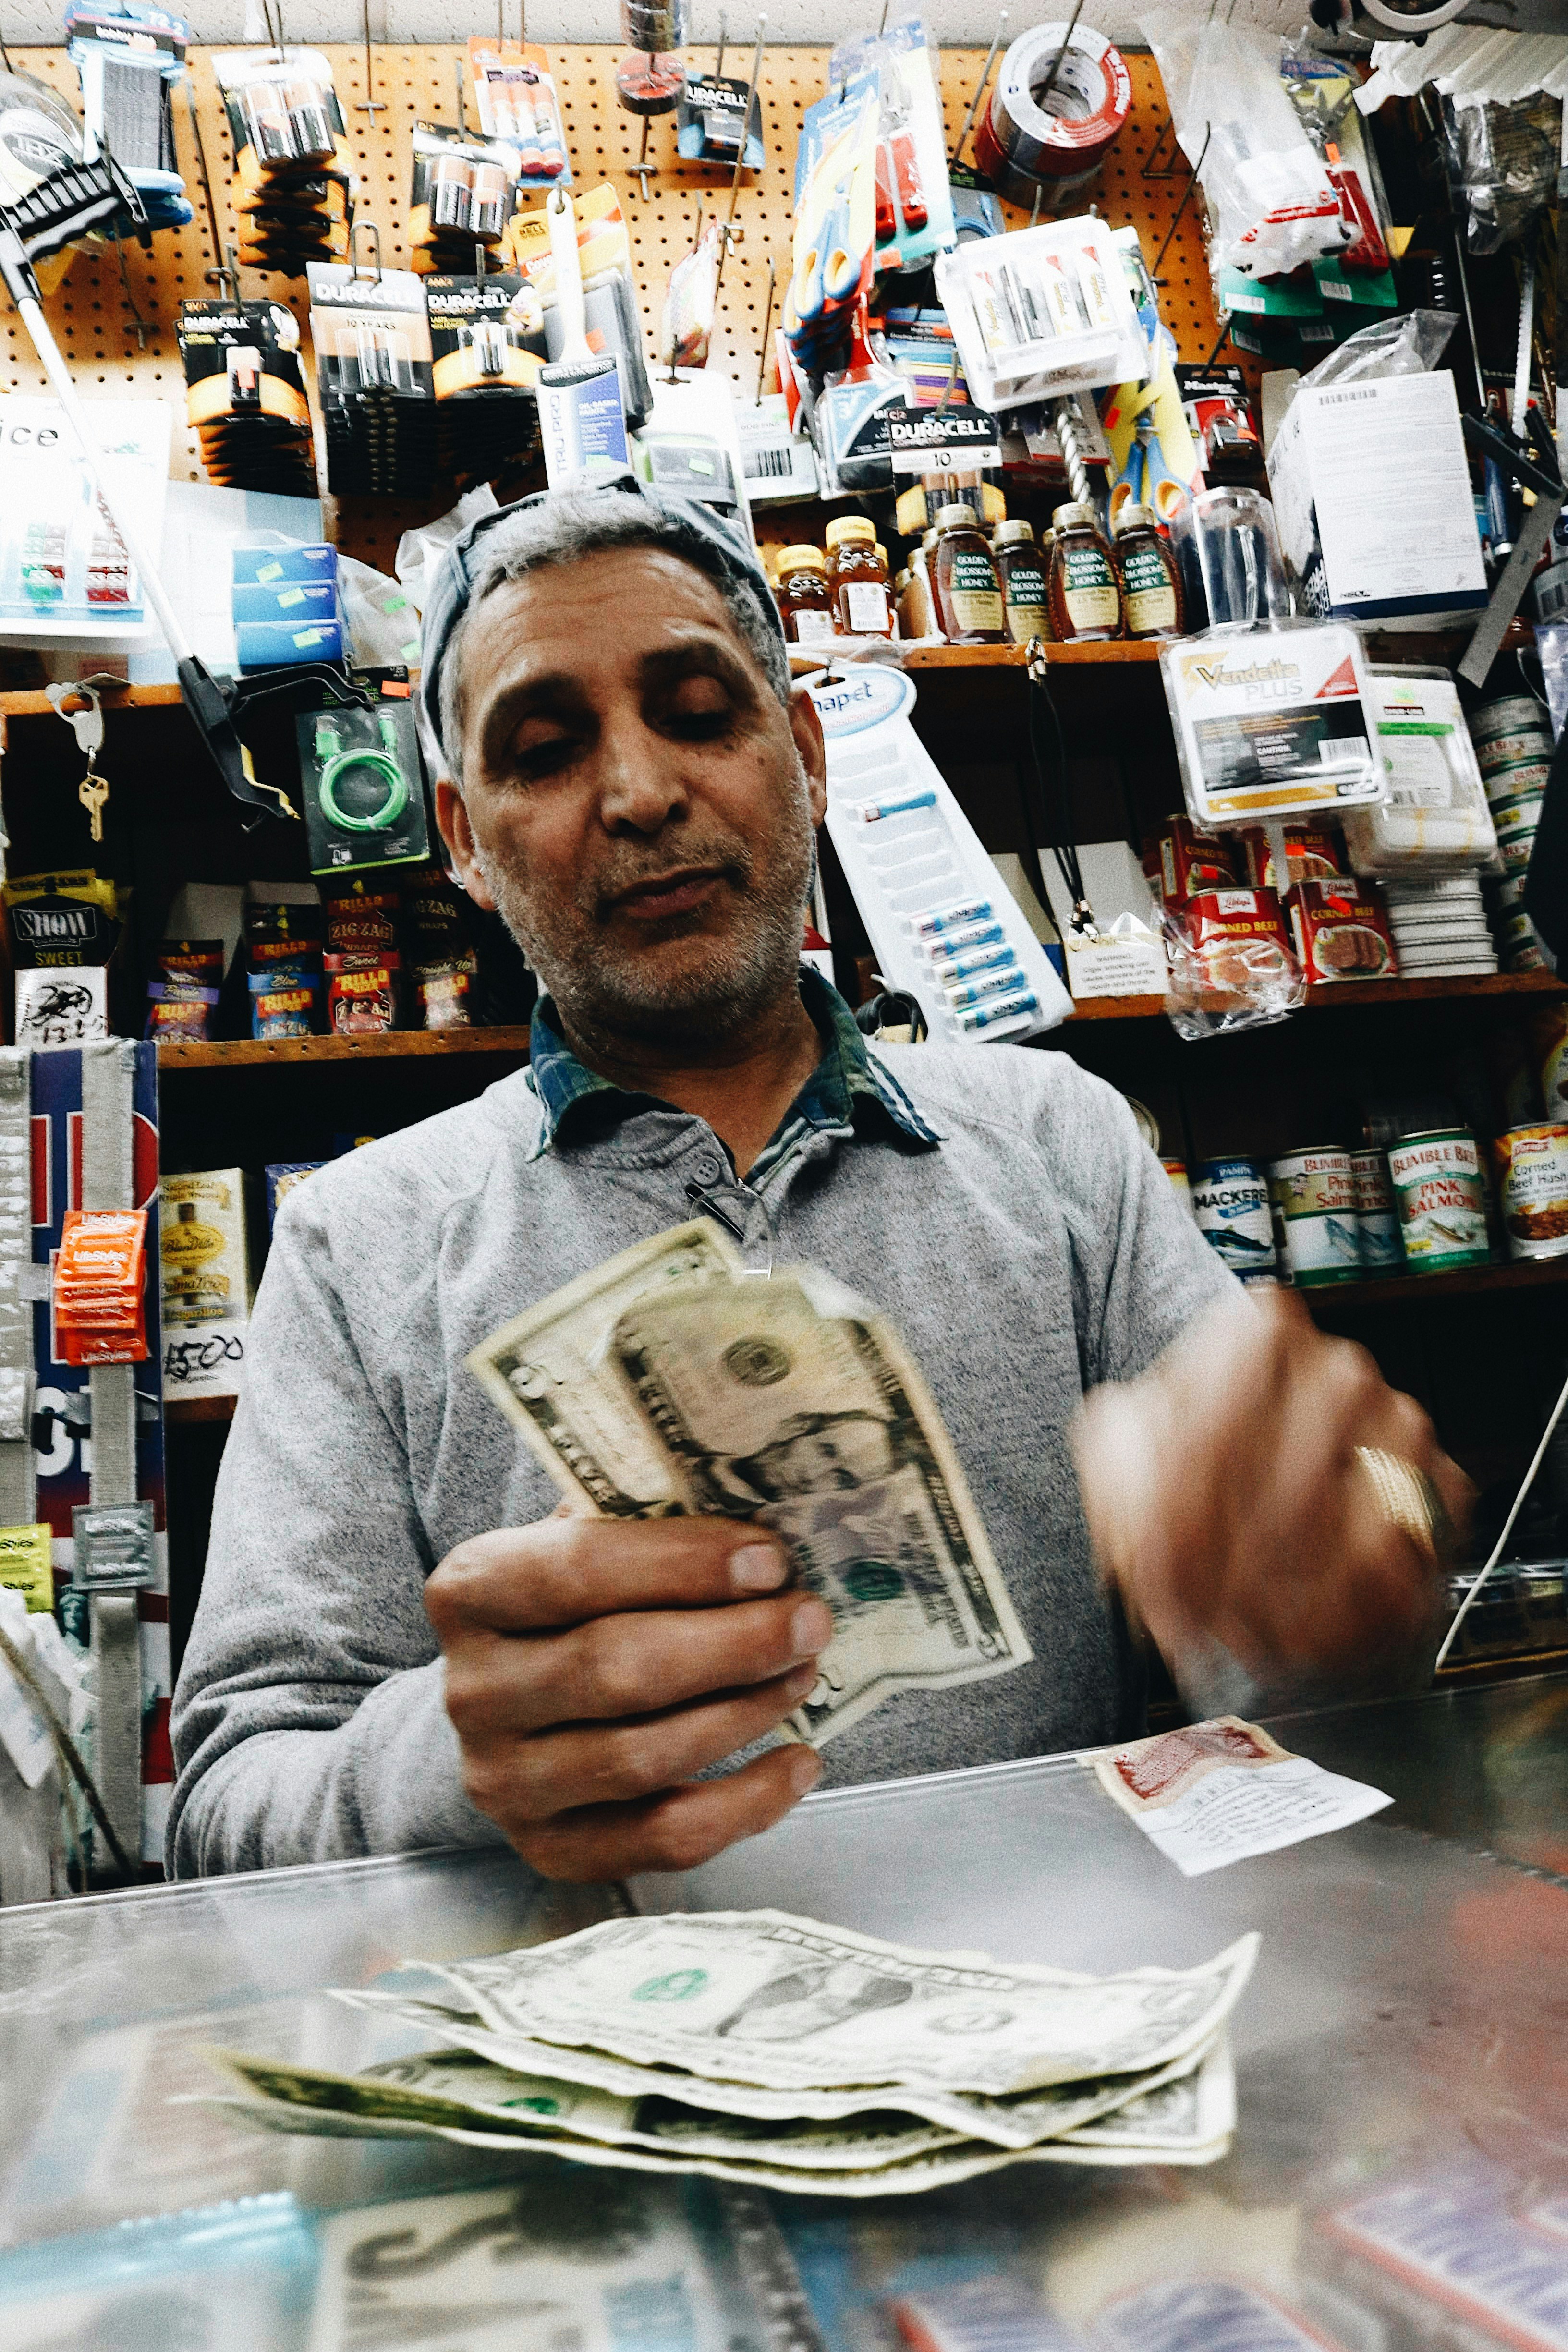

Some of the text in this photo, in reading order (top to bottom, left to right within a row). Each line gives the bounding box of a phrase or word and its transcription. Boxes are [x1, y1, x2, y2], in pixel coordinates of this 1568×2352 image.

[686, 85, 749, 109] URACELL
[427, 293, 511, 309] DURACELL
[184, 316, 250, 329] DURACELL
[359, 320, 396, 330] YEARS
[890, 419, 992, 440] DURACELL
[934, 452, 952, 466] 10
[956, 556, 989, 565] GOLDEN
[1070, 552, 1103, 564] GOLDEN
[1125, 553, 1158, 568] GOLDEN
[956, 567, 994, 576] BLOSSOM
[1011, 570, 1042, 580] GOLDEN
[1069, 563, 1107, 576] BLOSSOM
[1125, 564, 1164, 580] BLOSSOM
[961, 578, 989, 588] HONEY
[1011, 582, 1045, 591] BLOSSOM
[1074, 575, 1103, 586] HONEY
[1130, 576, 1159, 590] HONEY
[1016, 593, 1042, 602] HONEY
[1196, 658, 1300, 690] Vendetta
[813, 681, 872, 712] hapet
[1245, 680, 1303, 699] PLUS
[1354, 906, 1374, 916] BEEF
[20, 911, 87, 938] SHOW
[1254, 921, 1279, 932] BEEF
[35, 951, 84, 966] SWEET
[1394, 1148, 1451, 1176] BUMBLE
[1513, 1160, 1556, 1176] Corned
[1420, 1179, 1460, 1198] PINK
[1509, 1176, 1532, 1191] Beef
[1193, 1189, 1269, 1210] MACKERE
[1408, 1194, 1476, 1218] SALMON
[81, 1213, 135, 1226] LifeStyles
[73, 1250, 128, 1262] LifeStyles
[80, 1350, 134, 1362] LifeStyles
